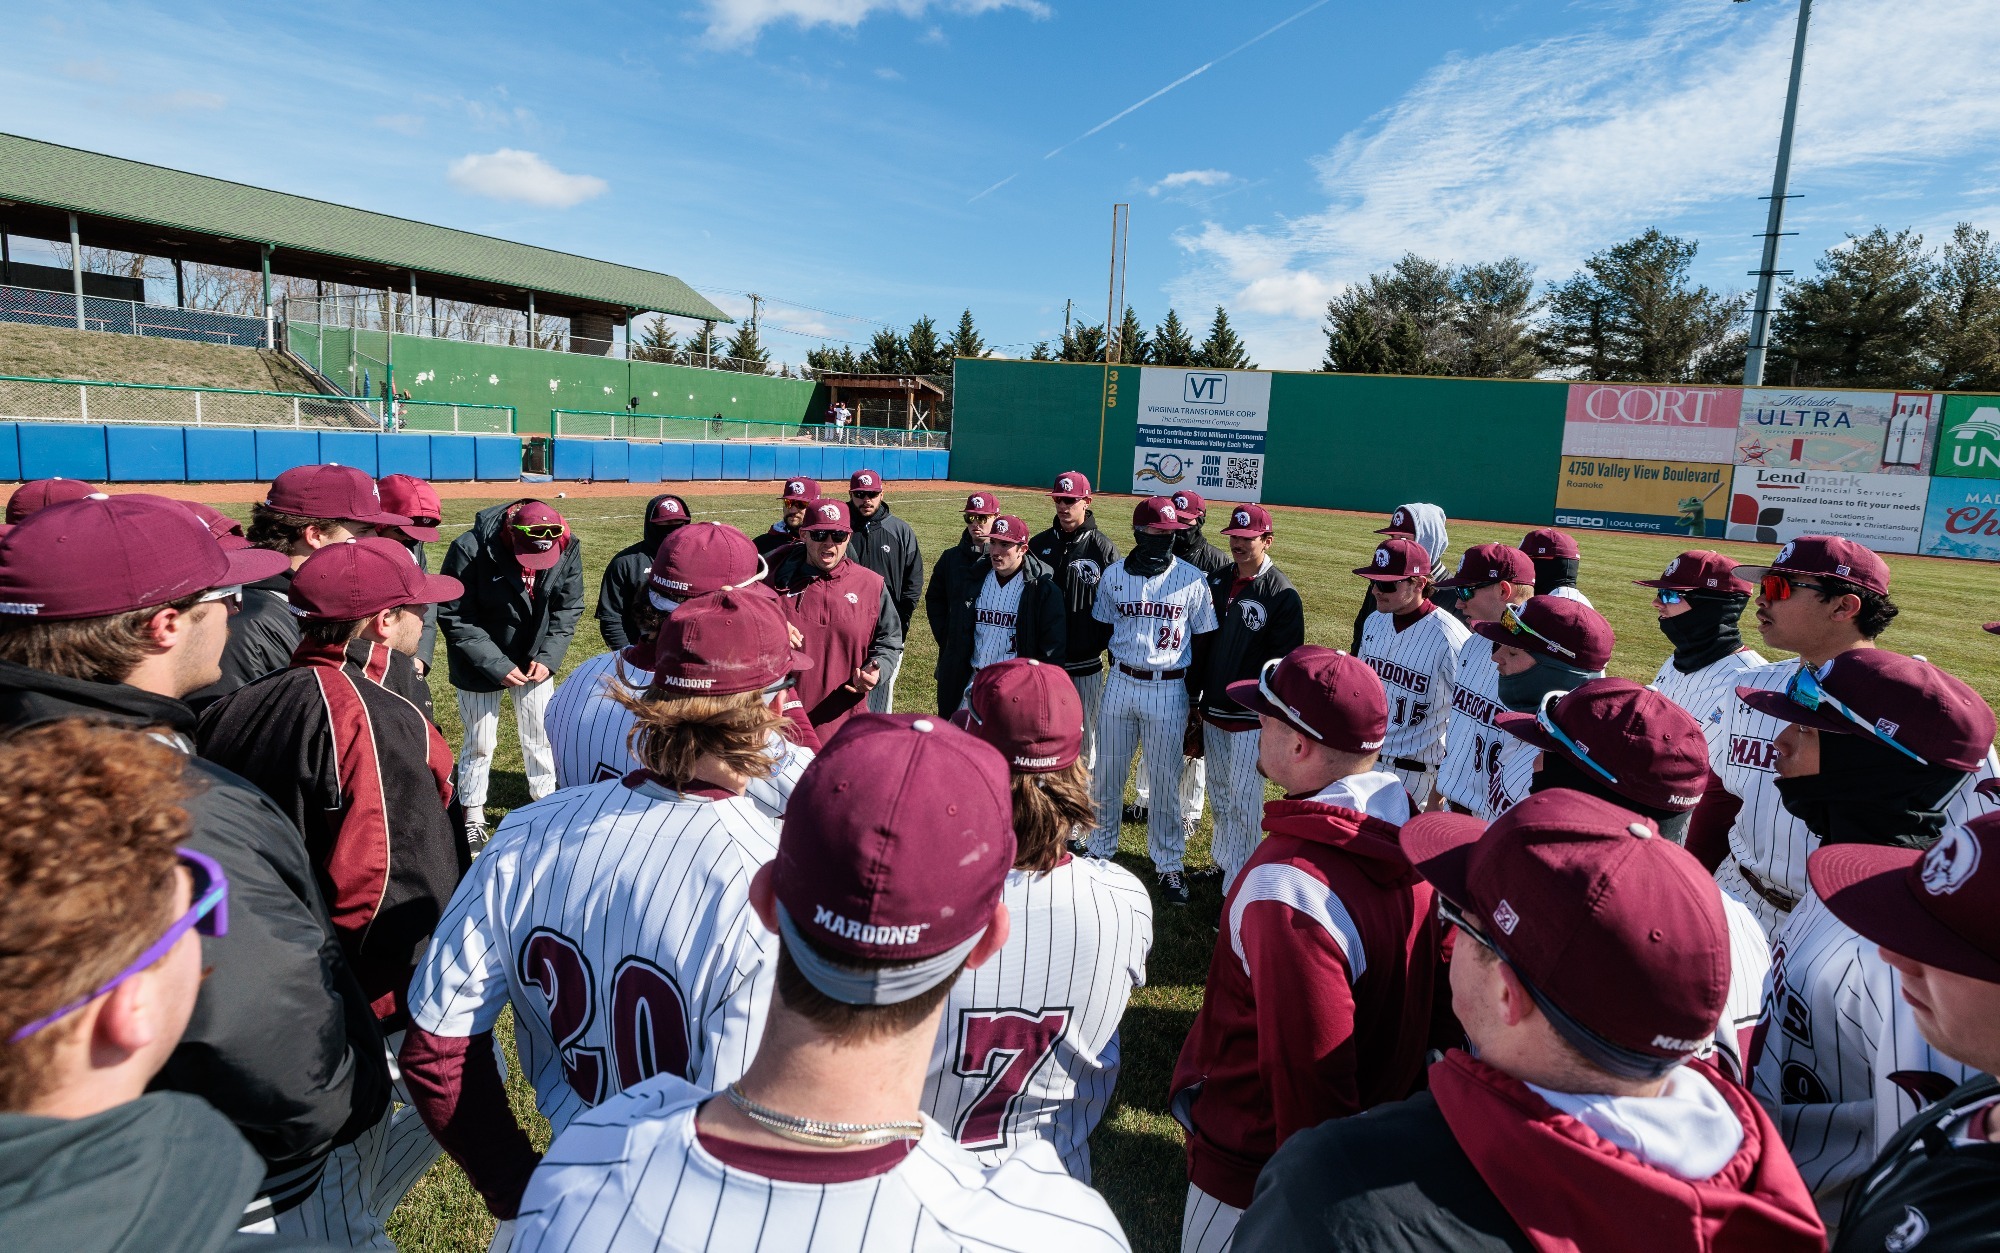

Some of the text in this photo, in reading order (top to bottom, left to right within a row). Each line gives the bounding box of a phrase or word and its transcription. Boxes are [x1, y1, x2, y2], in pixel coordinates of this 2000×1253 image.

[1107, 370, 1119, 408] 325
[1190, 377, 1223, 400] VT
[1585, 387, 1718, 424] CORT
[1771, 394, 1839, 407] Michelob
[1147, 405, 1257, 418] VIRGINIA TRANSFORMER CORP
[1172, 416, 1212, 424] Commitment
[1212, 419, 1241, 428] Company
[1757, 409, 1851, 429] ULTRA
[1163, 428, 1193, 437] Contribute
[1193, 430, 1208, 438] $100
[1208, 431, 1228, 439] Million
[1235, 432, 1264, 441] Economic
[1592, 424, 1635, 434] Furniture
[1637, 426, 1667, 436] Rental
[1681, 428, 1706, 437] Sales
[1146, 436, 1166, 445] Impact
[1183, 438, 1208, 446] Roanoke
[1209, 440, 1226, 448] Valley
[1580, 436, 1716, 449] Events Destination Services
[1201, 454, 1221, 466] JOIN
[1570, 446, 1724, 460] cort.com 888.360.2678
[1201, 466, 1220, 476] OUR
[1568, 461, 1720, 484] 4750 Valley View Boulevard
[1196, 476, 1224, 488] TEAM!
[1566, 480, 1604, 489] Roanoke
[1756, 470, 1862, 488] Lendmark
[1804, 486, 1903, 498] Financial Services
[1762, 494, 1818, 504] Personalized
[1820, 497, 1844, 507] loans
[1857, 500, 1868, 508] fit
[1869, 502, 1891, 510] your
[1892, 503, 1921, 512] needs
[1555, 516, 1661, 530] GEICO LOCAL OFFICE
[1830, 512, 1865, 521] Locations
[1786, 516, 1919, 533] Salem Roanoke Christiansburg
[653, 573, 688, 591] MAROONS
[1155, 625, 1182, 651] 29
[664, 674, 712, 689] MAROONS
[1392, 696, 1431, 727] 15
[1014, 756, 1058, 767] MAROONS
[813, 904, 921, 946] MAROONS
[518, 925, 693, 1108] 20
[952, 1005, 1075, 1152] 7
